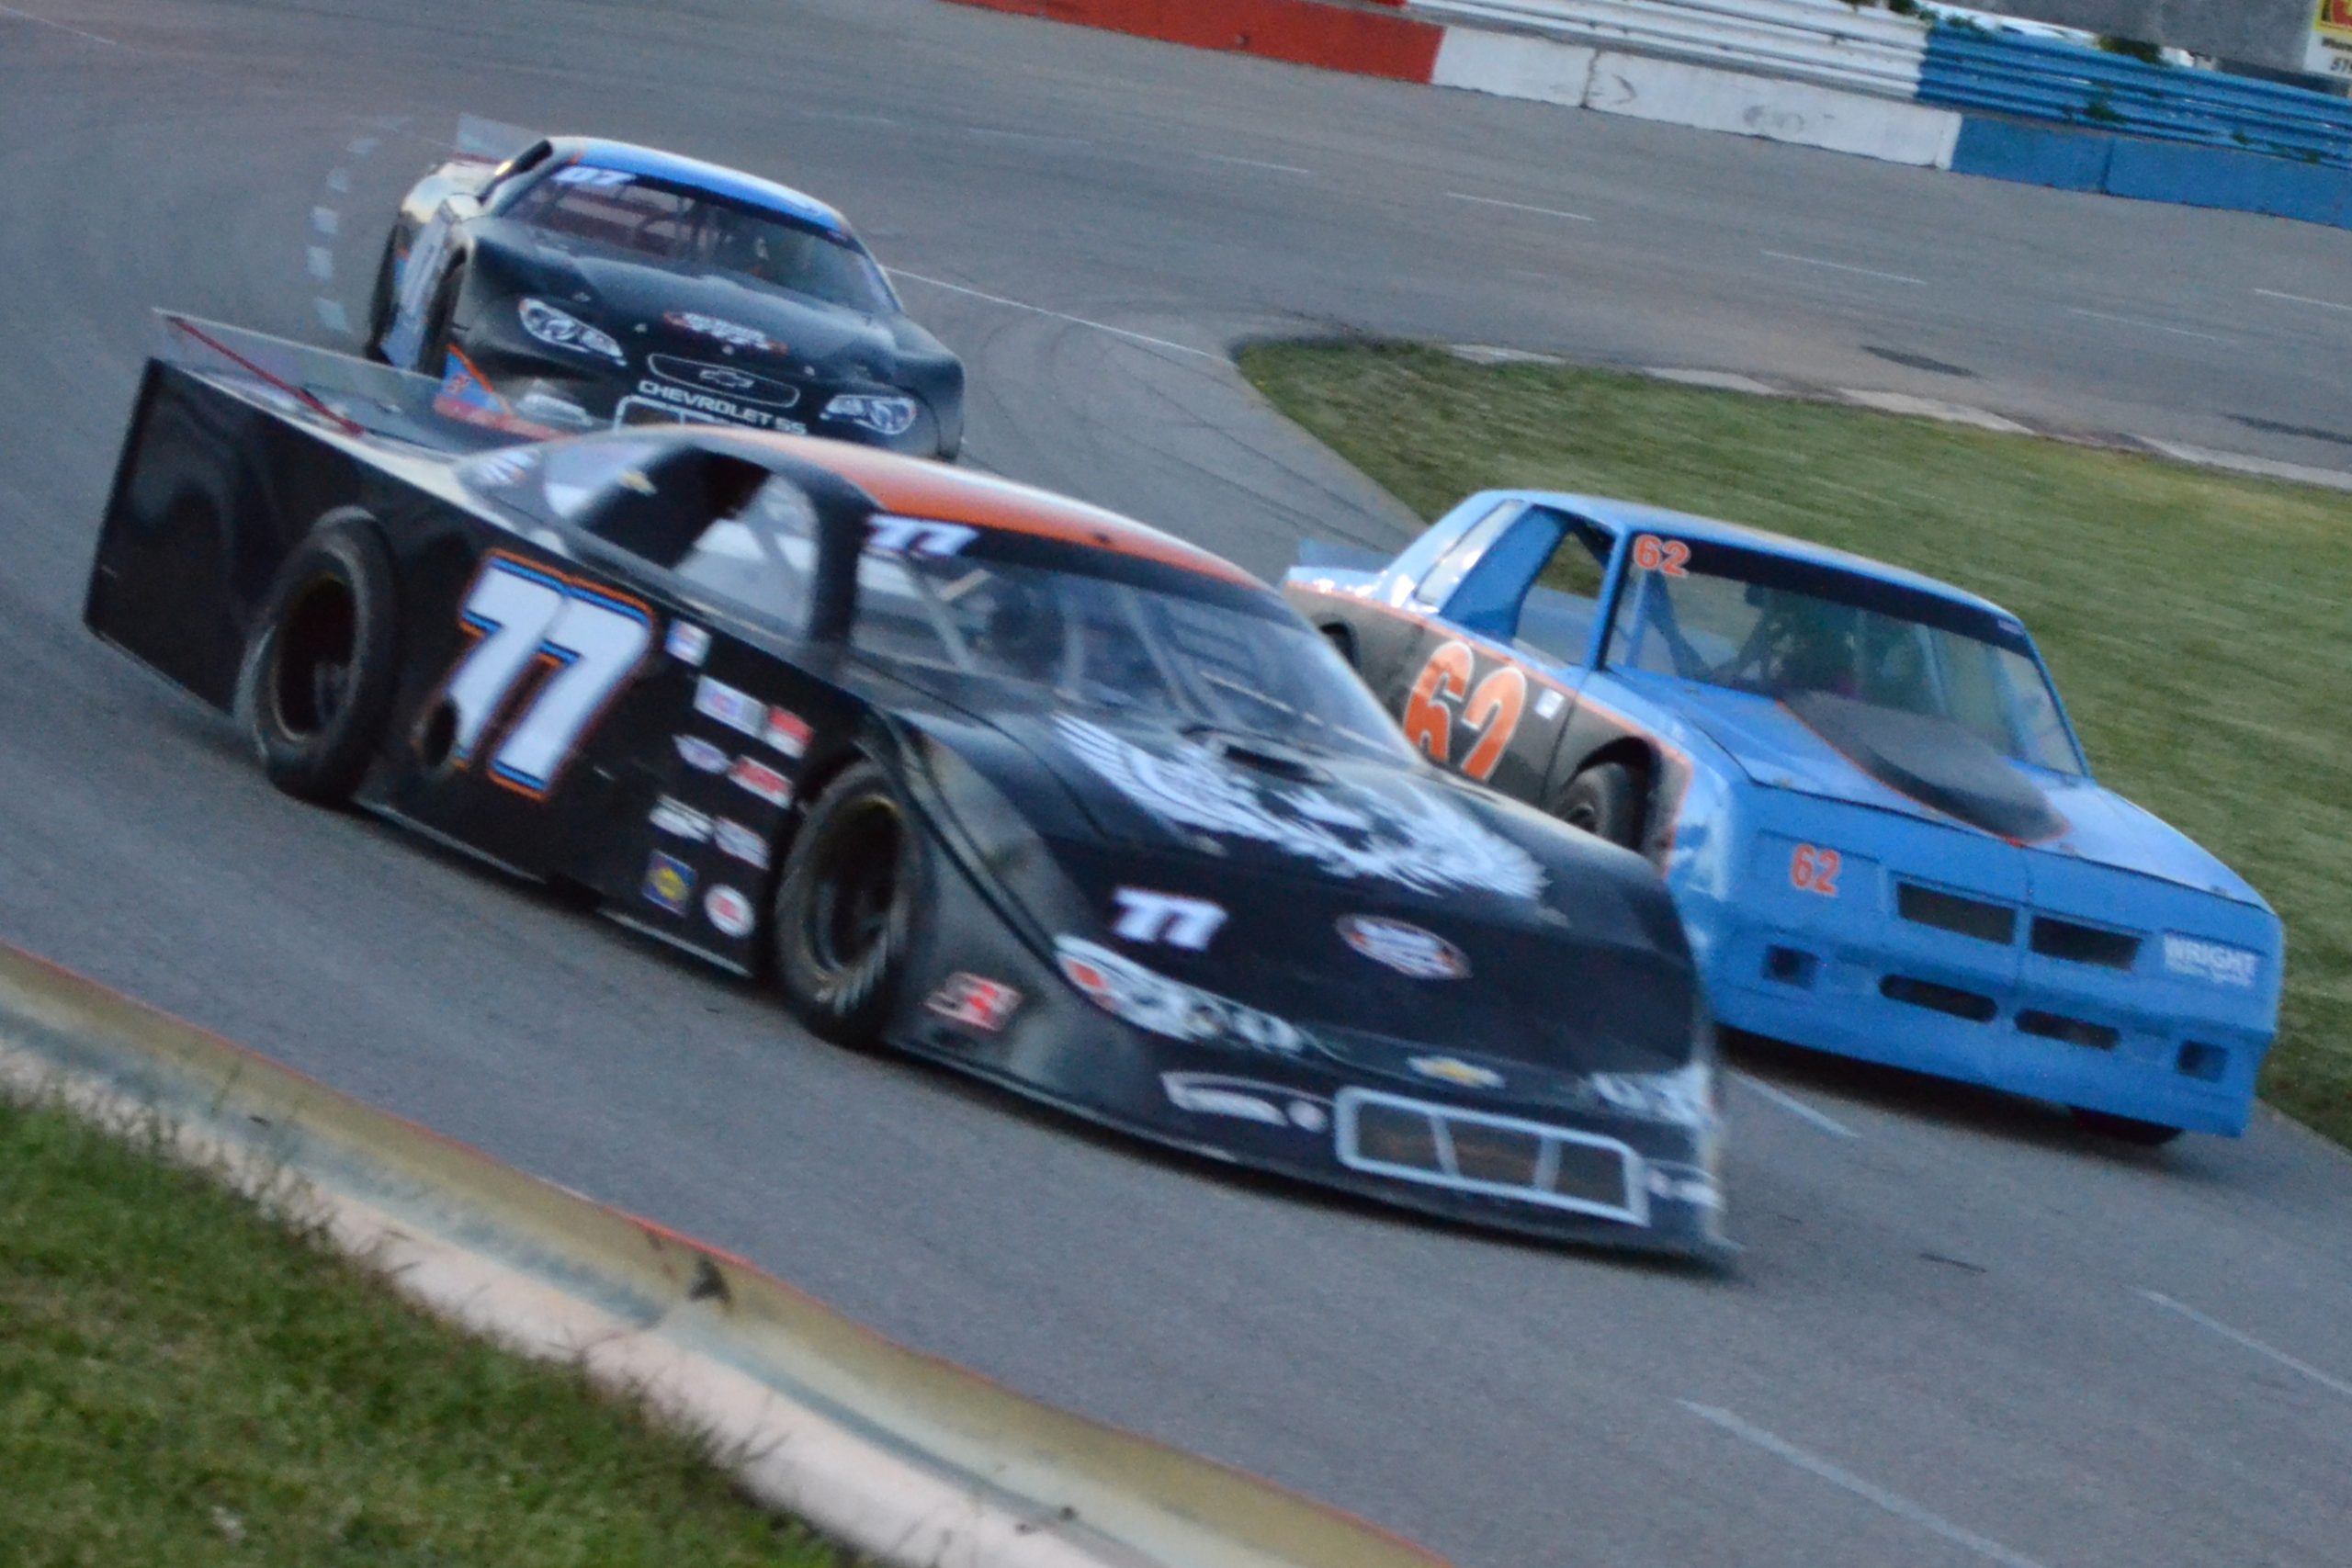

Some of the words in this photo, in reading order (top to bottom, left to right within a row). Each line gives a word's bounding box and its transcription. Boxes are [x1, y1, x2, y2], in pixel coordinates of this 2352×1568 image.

[638, 379, 772, 425] CHEVROLET
[774, 416, 808, 435] SS
[1634, 534, 1690, 578] 62
[443, 547, 655, 802] 77
[1403, 640, 1526, 782] 62
[1792, 843, 1841, 898] 62
[1113, 886, 1228, 952] 77
